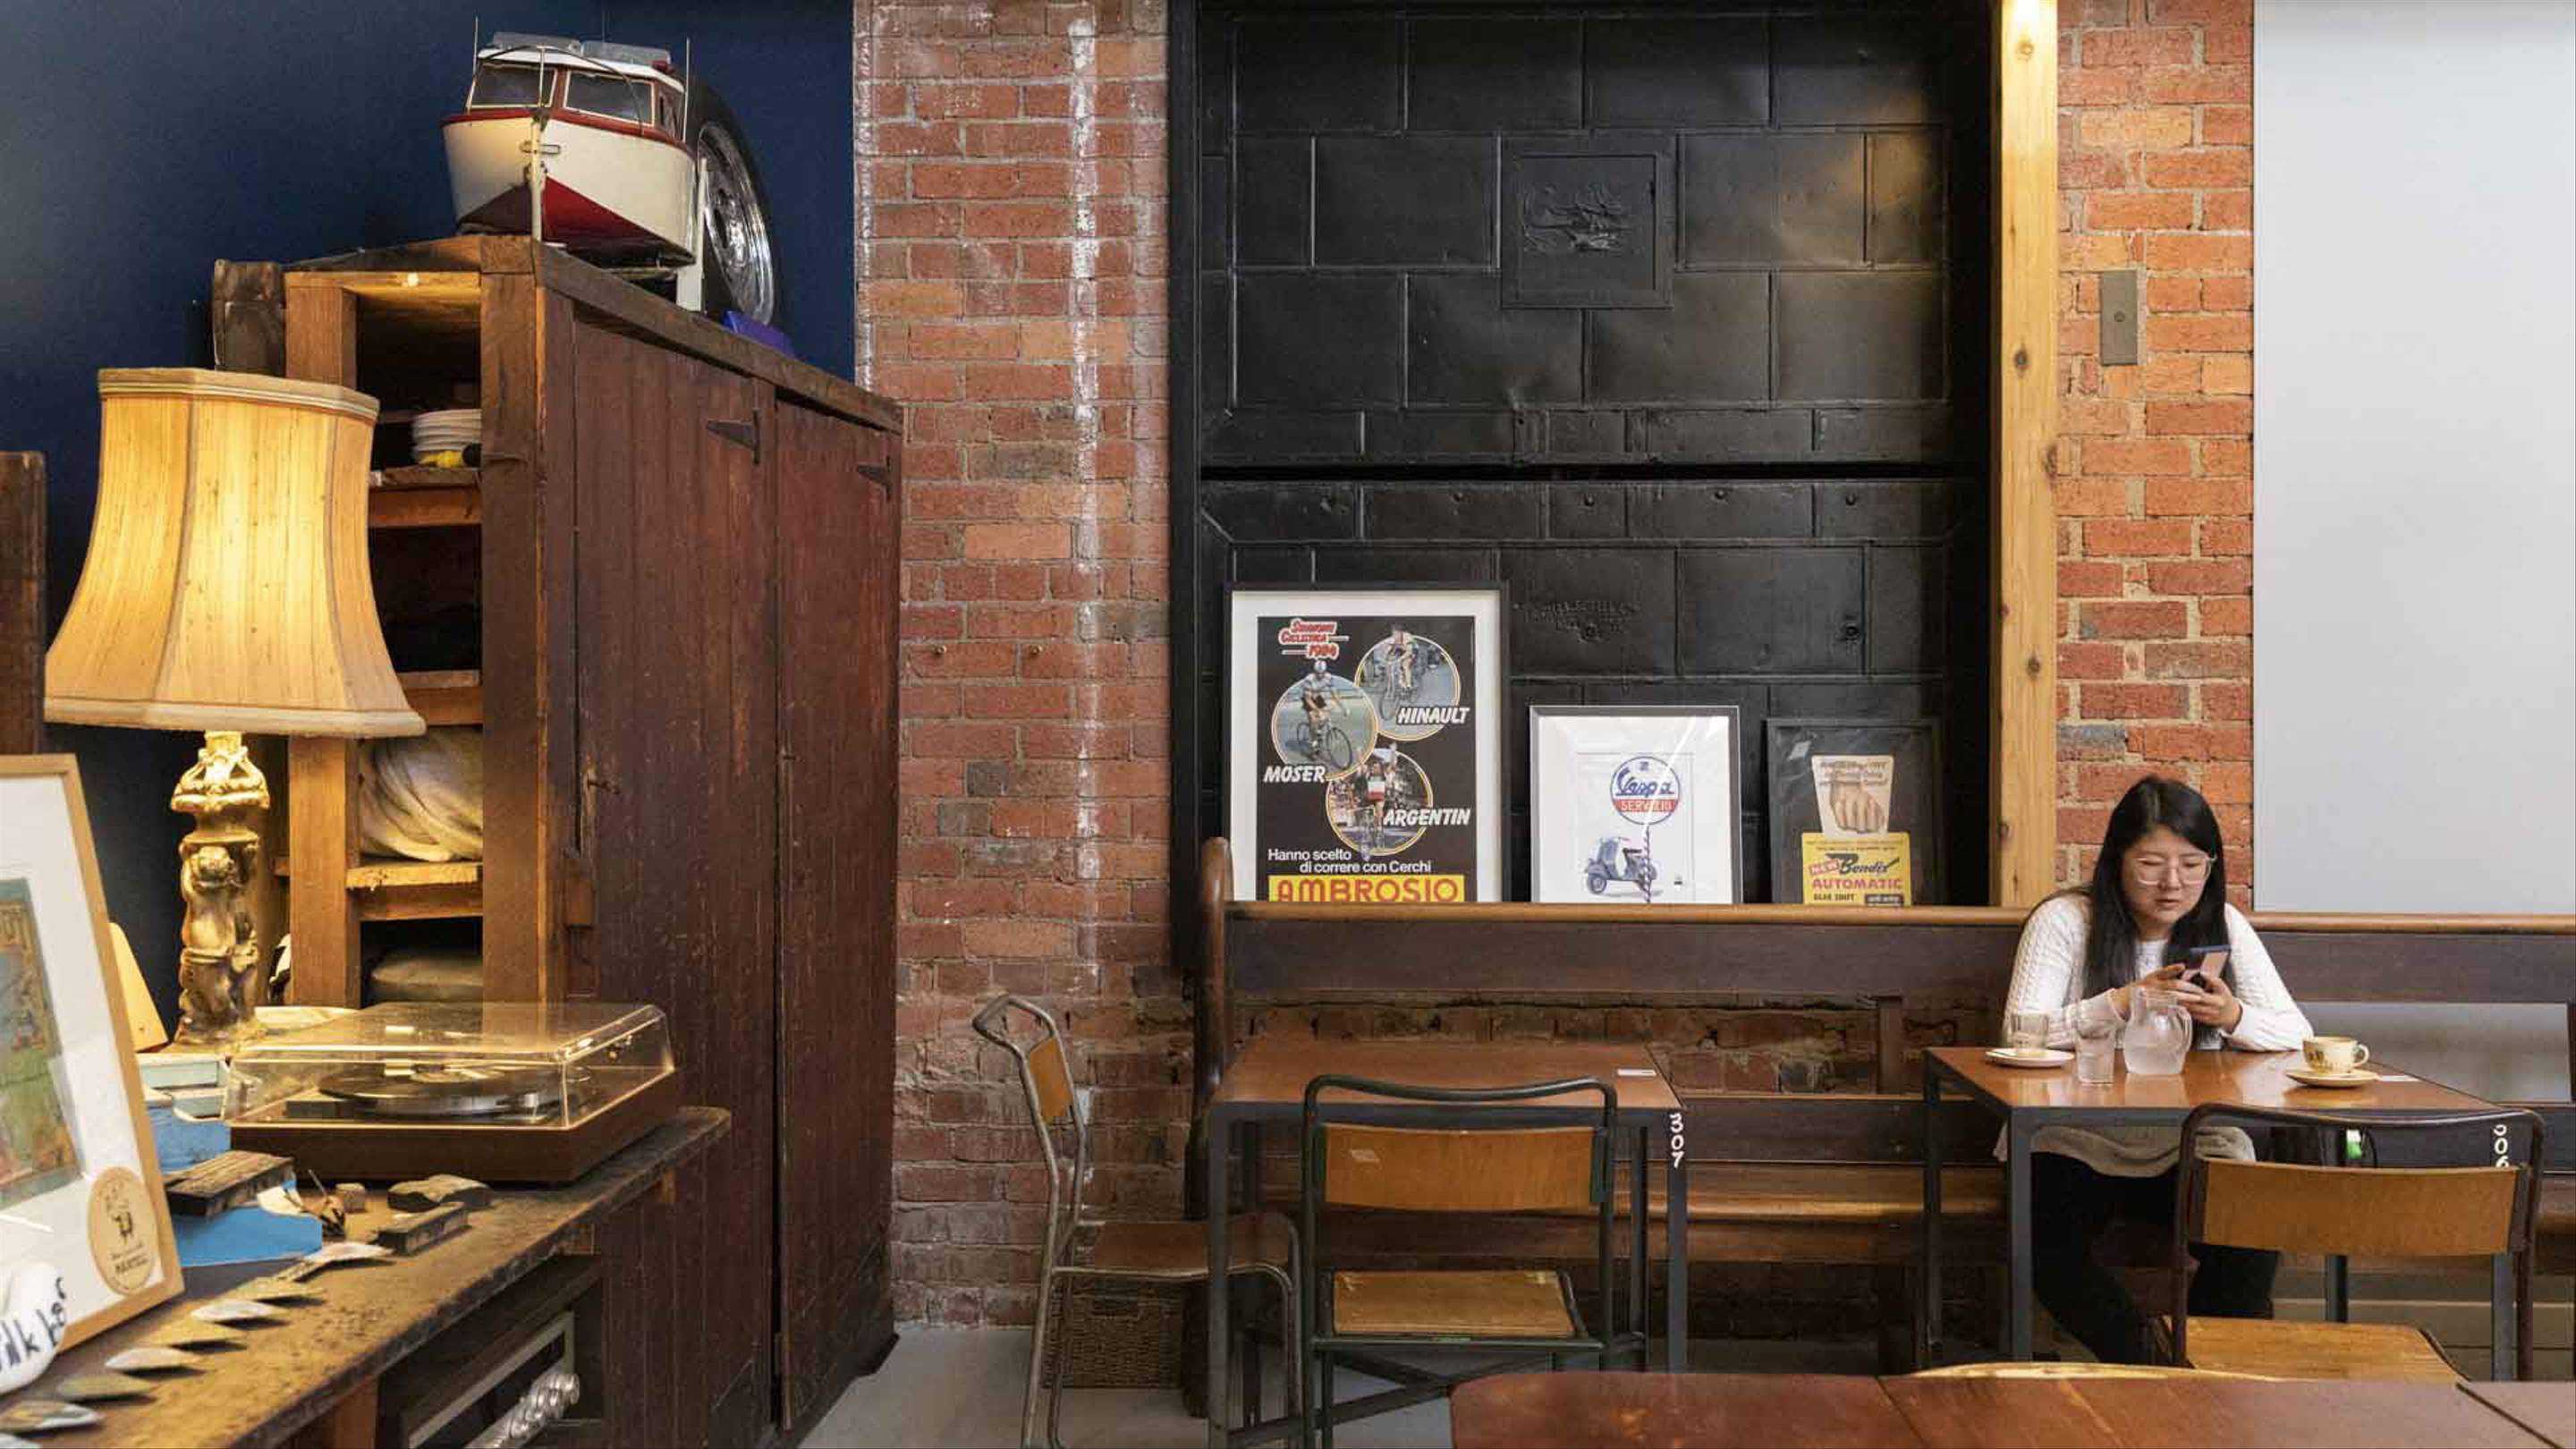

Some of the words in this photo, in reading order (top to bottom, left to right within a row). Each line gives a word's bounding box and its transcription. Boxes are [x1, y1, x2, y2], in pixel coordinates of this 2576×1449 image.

[1397, 708, 1470, 724] HINAULT
[1263, 766, 1326, 783] MOSER
[1615, 767, 1675, 798] Vespa
[1383, 808, 1470, 826] ARGENTIN
[1267, 849, 1310, 861] Hanno
[1312, 849, 1352, 861] scelto
[1299, 861, 1312, 873] di
[1314, 863, 1360, 873] correre
[1362, 863, 1387, 873] con
[1388, 860, 1432, 873] Cerchi
[1277, 878, 1459, 902] AMBROSIO
[1813, 878, 1903, 889] AUTOMATIC
[1669, 1112, 1685, 1169] 307
